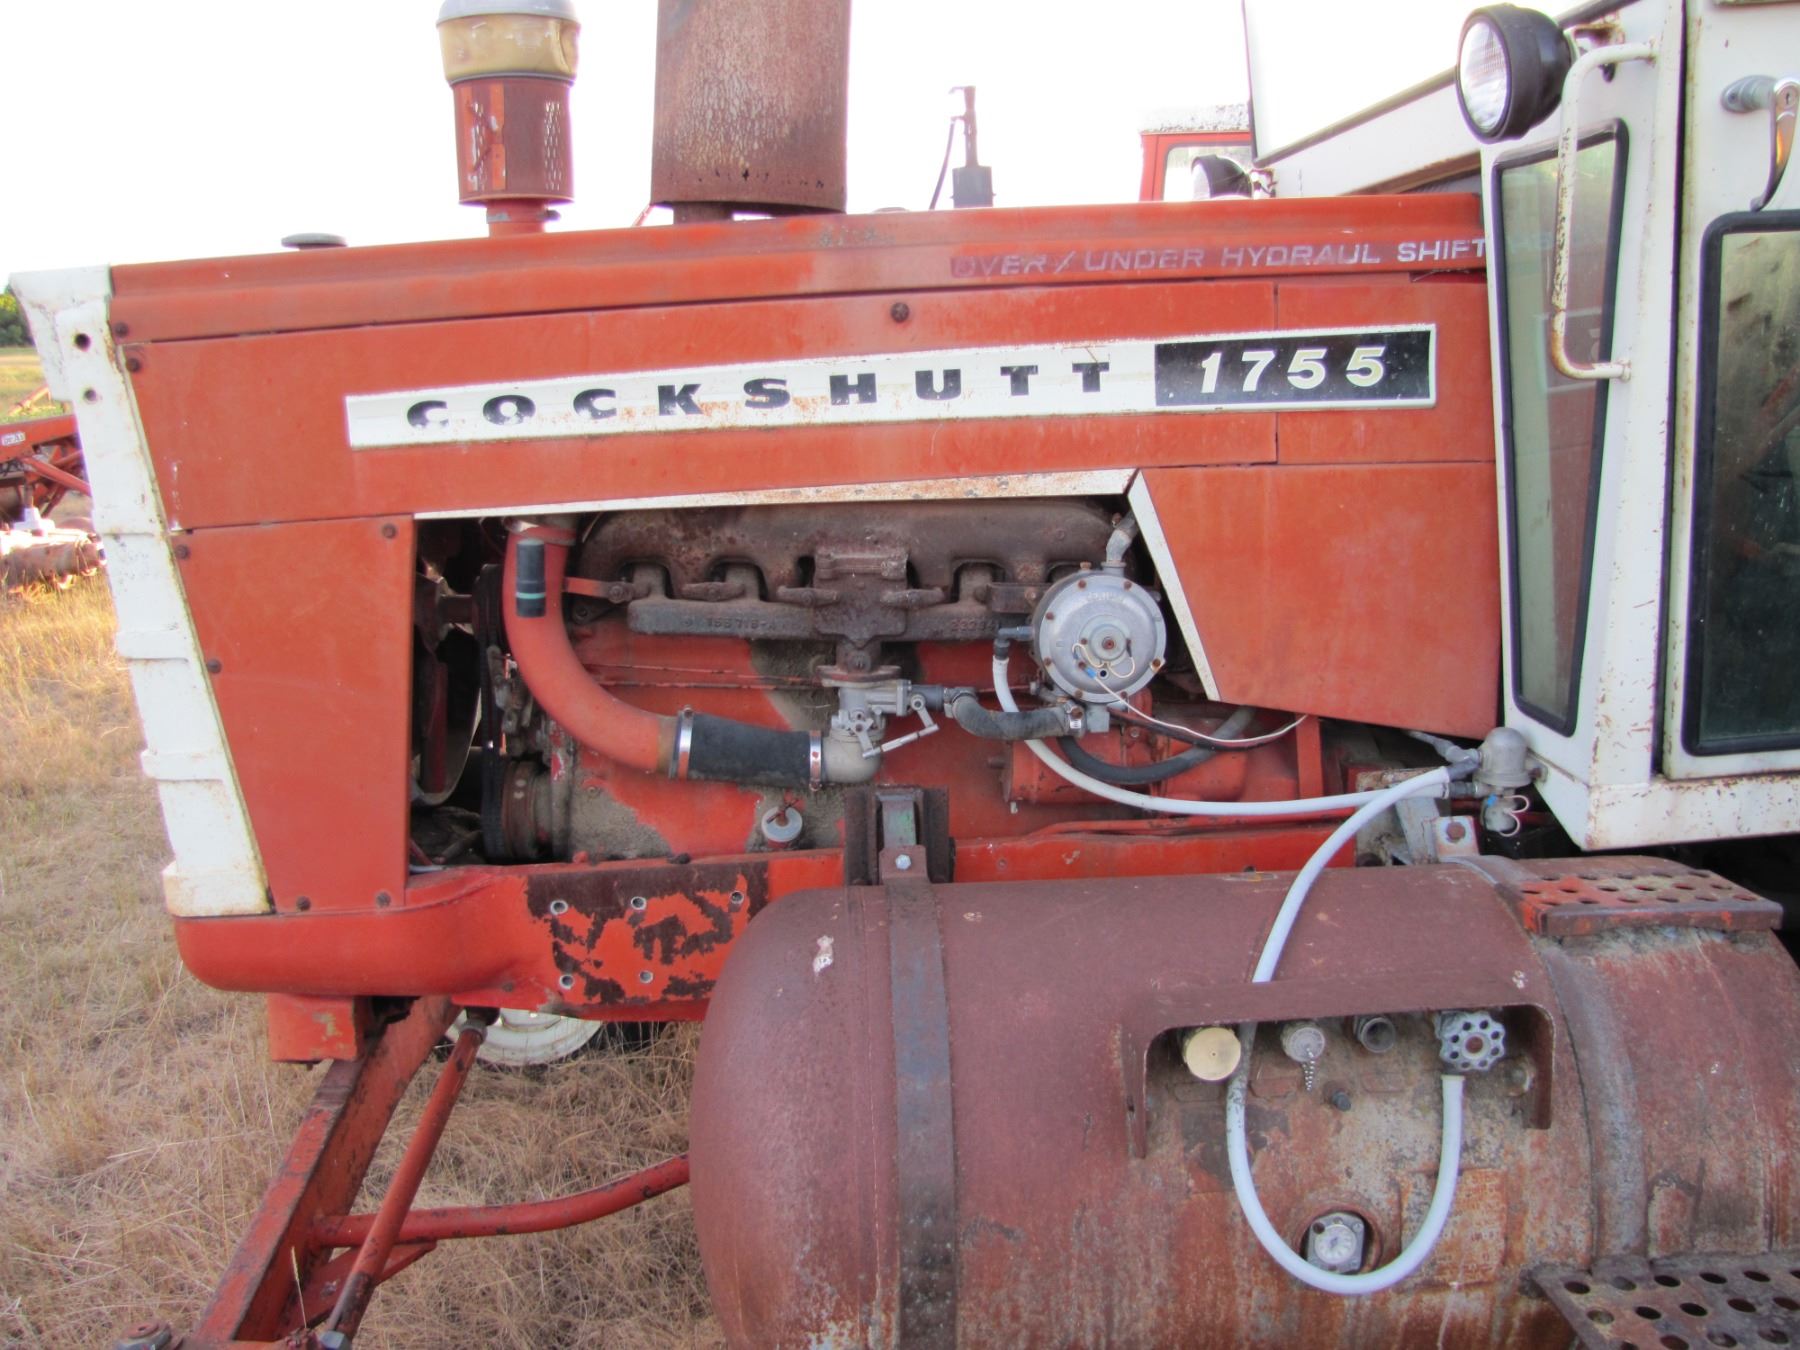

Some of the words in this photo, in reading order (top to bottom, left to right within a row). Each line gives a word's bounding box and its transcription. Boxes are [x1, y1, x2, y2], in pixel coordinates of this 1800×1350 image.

[1220, 243, 1381, 268] HYDRAUL
[1397, 238, 1486, 262] SHIFT
[406, 361, 1111, 429] COCKSHUTT
[1201, 346, 1386, 394] 1755
